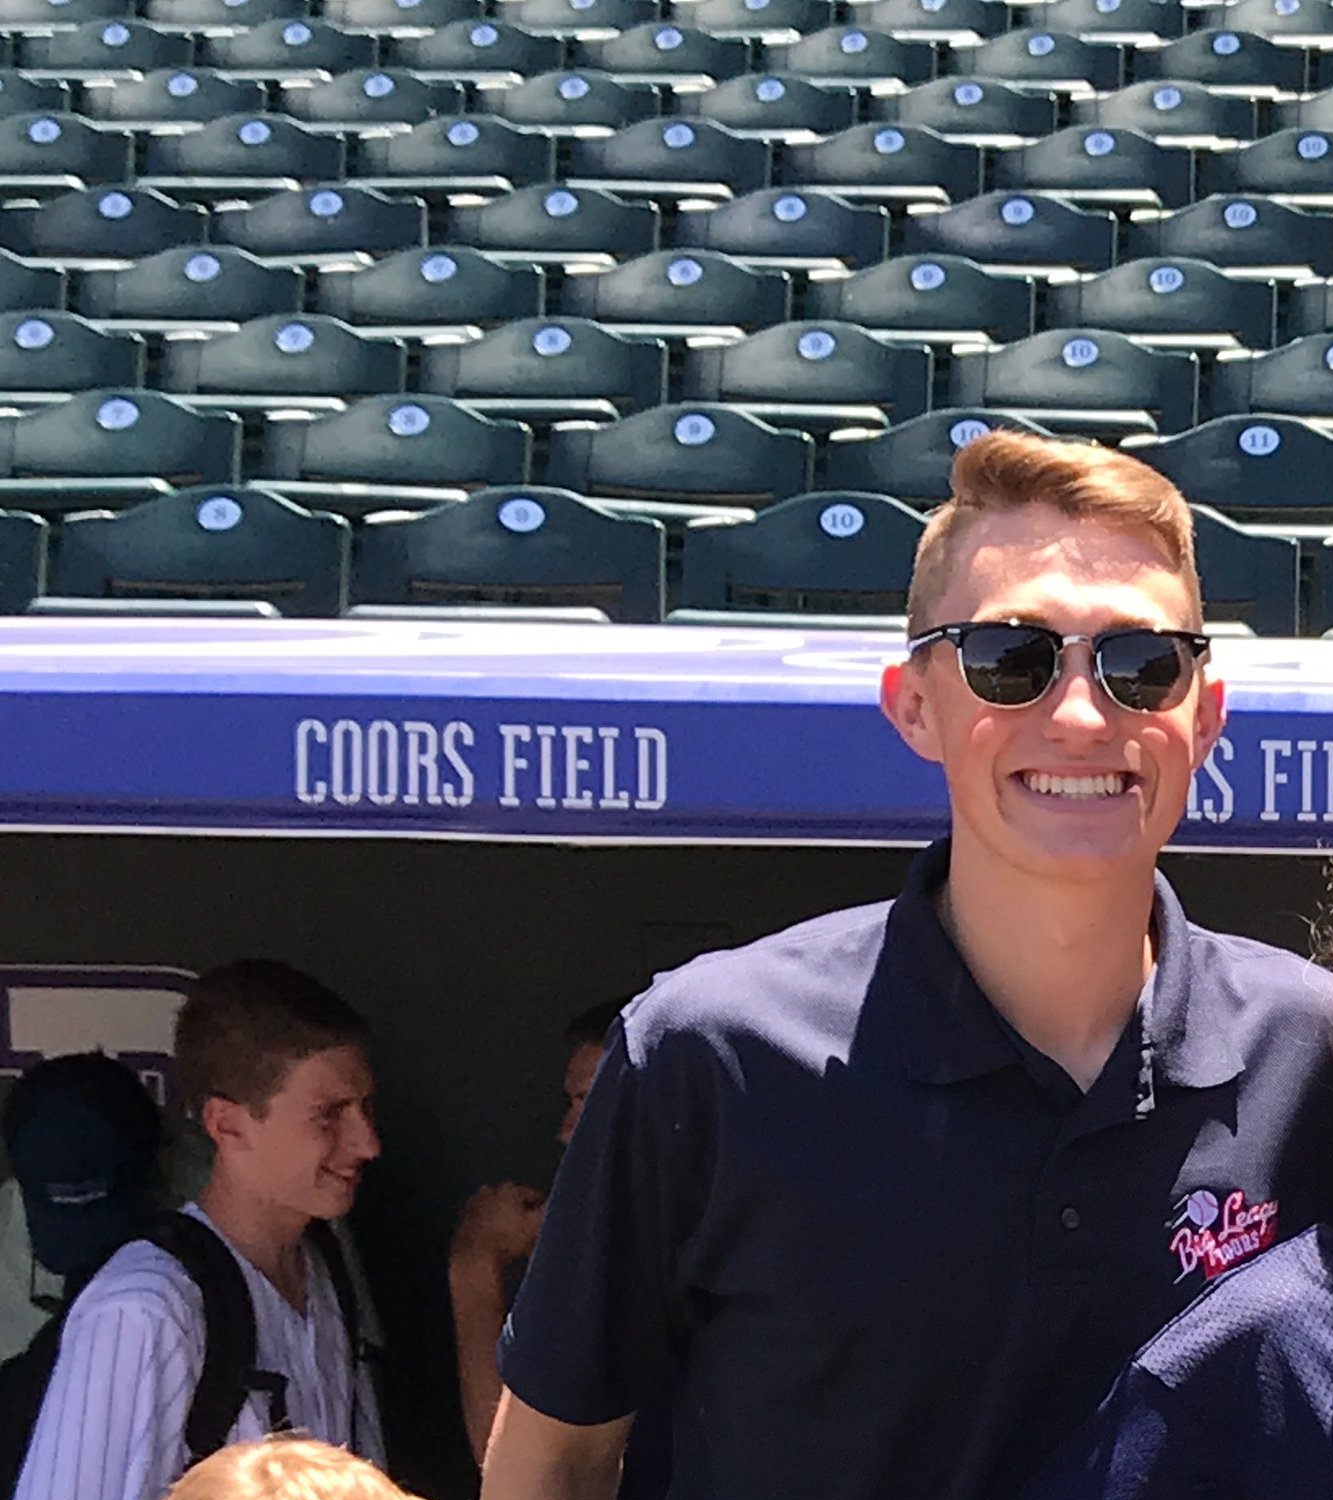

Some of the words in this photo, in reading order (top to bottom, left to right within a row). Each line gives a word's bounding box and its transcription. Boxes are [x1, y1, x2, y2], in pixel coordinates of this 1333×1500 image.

[295, 718, 475, 808] COORS
[499, 723, 668, 810] FIELD
[1169, 1227, 1217, 1285] Big
[1218, 1190, 1279, 1242] Leagu
